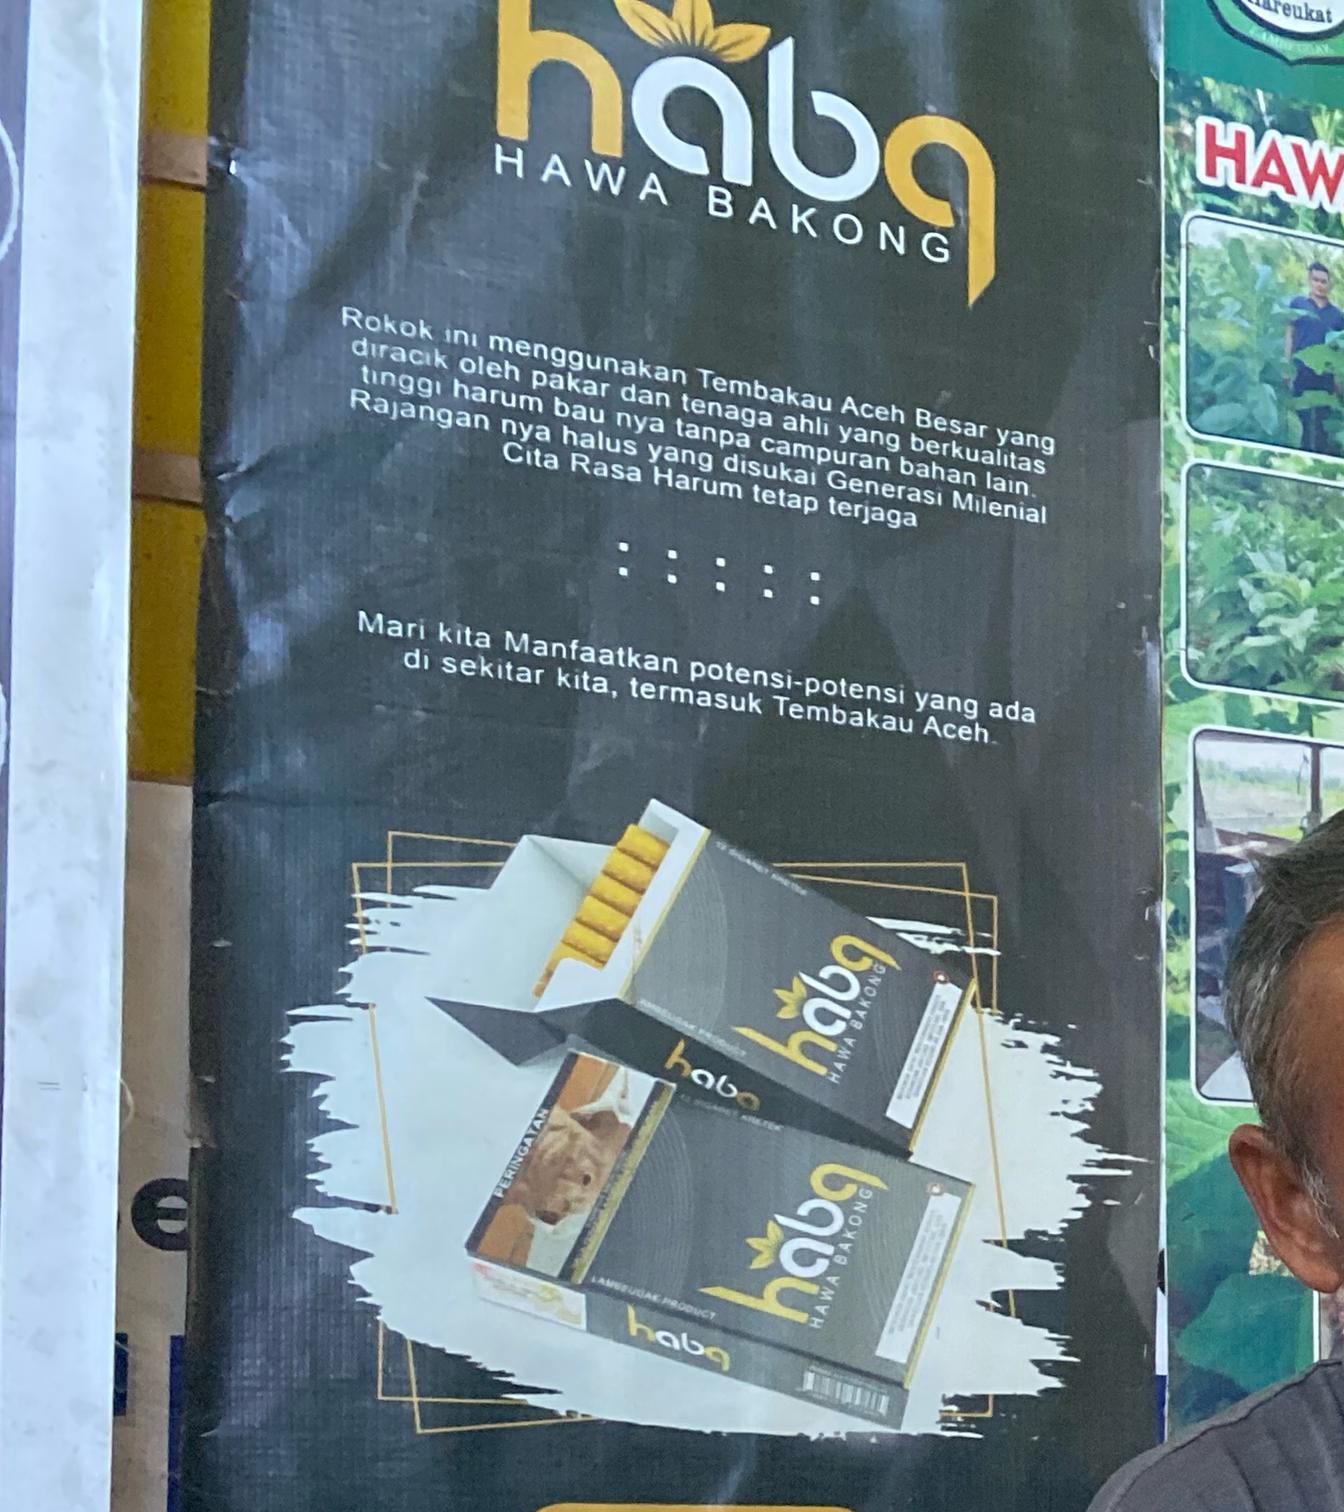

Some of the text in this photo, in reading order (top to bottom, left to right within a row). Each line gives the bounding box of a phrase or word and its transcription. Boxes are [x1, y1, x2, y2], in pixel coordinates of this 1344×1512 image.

[1252, 0, 1334, 24] areukat
[495, 143, 951, 264] HAWA BAKONG
[341, 306, 433, 341] Rokok
[488, 333, 687, 386] menggunakan
[695, 367, 833, 413] Tembakau
[840, 396, 905, 424] Aceh
[915, 407, 989, 440] Besar
[996, 427, 1056, 456] yang
[351, 338, 1047, 475] diracik oleh pakar dan tenaga ahli yang berkualitas
[361, 365, 441, 397] tinggi
[453, 379, 544, 413] harum
[554, 395, 605, 424] bau
[616, 410, 665, 435] nya
[676, 417, 750, 450] tanpa
[760, 435, 890, 472] campuran
[900, 456, 976, 487] bahan
[349, 387, 1047, 525] Rajangan nya halus yang disukai Generasi Milenial
[502, 441, 919, 530] Cita Rasa Harum tetap terjaga
[358, 610, 1036, 723] Mari kita Manfaatkan potensi-potensi yang ada
[403, 648, 430, 670] di
[441, 654, 545, 684] sekitar
[557, 667, 618, 698] kita,
[629, 675, 762, 714] termasuk
[772, 694, 913, 733] Tembakau
[825, 962, 888, 1085] HAWA BAKONG
[493, 1108, 550, 1198] PERINGATAN
[808, 1186, 873, 1330] HAWA BAKONG
